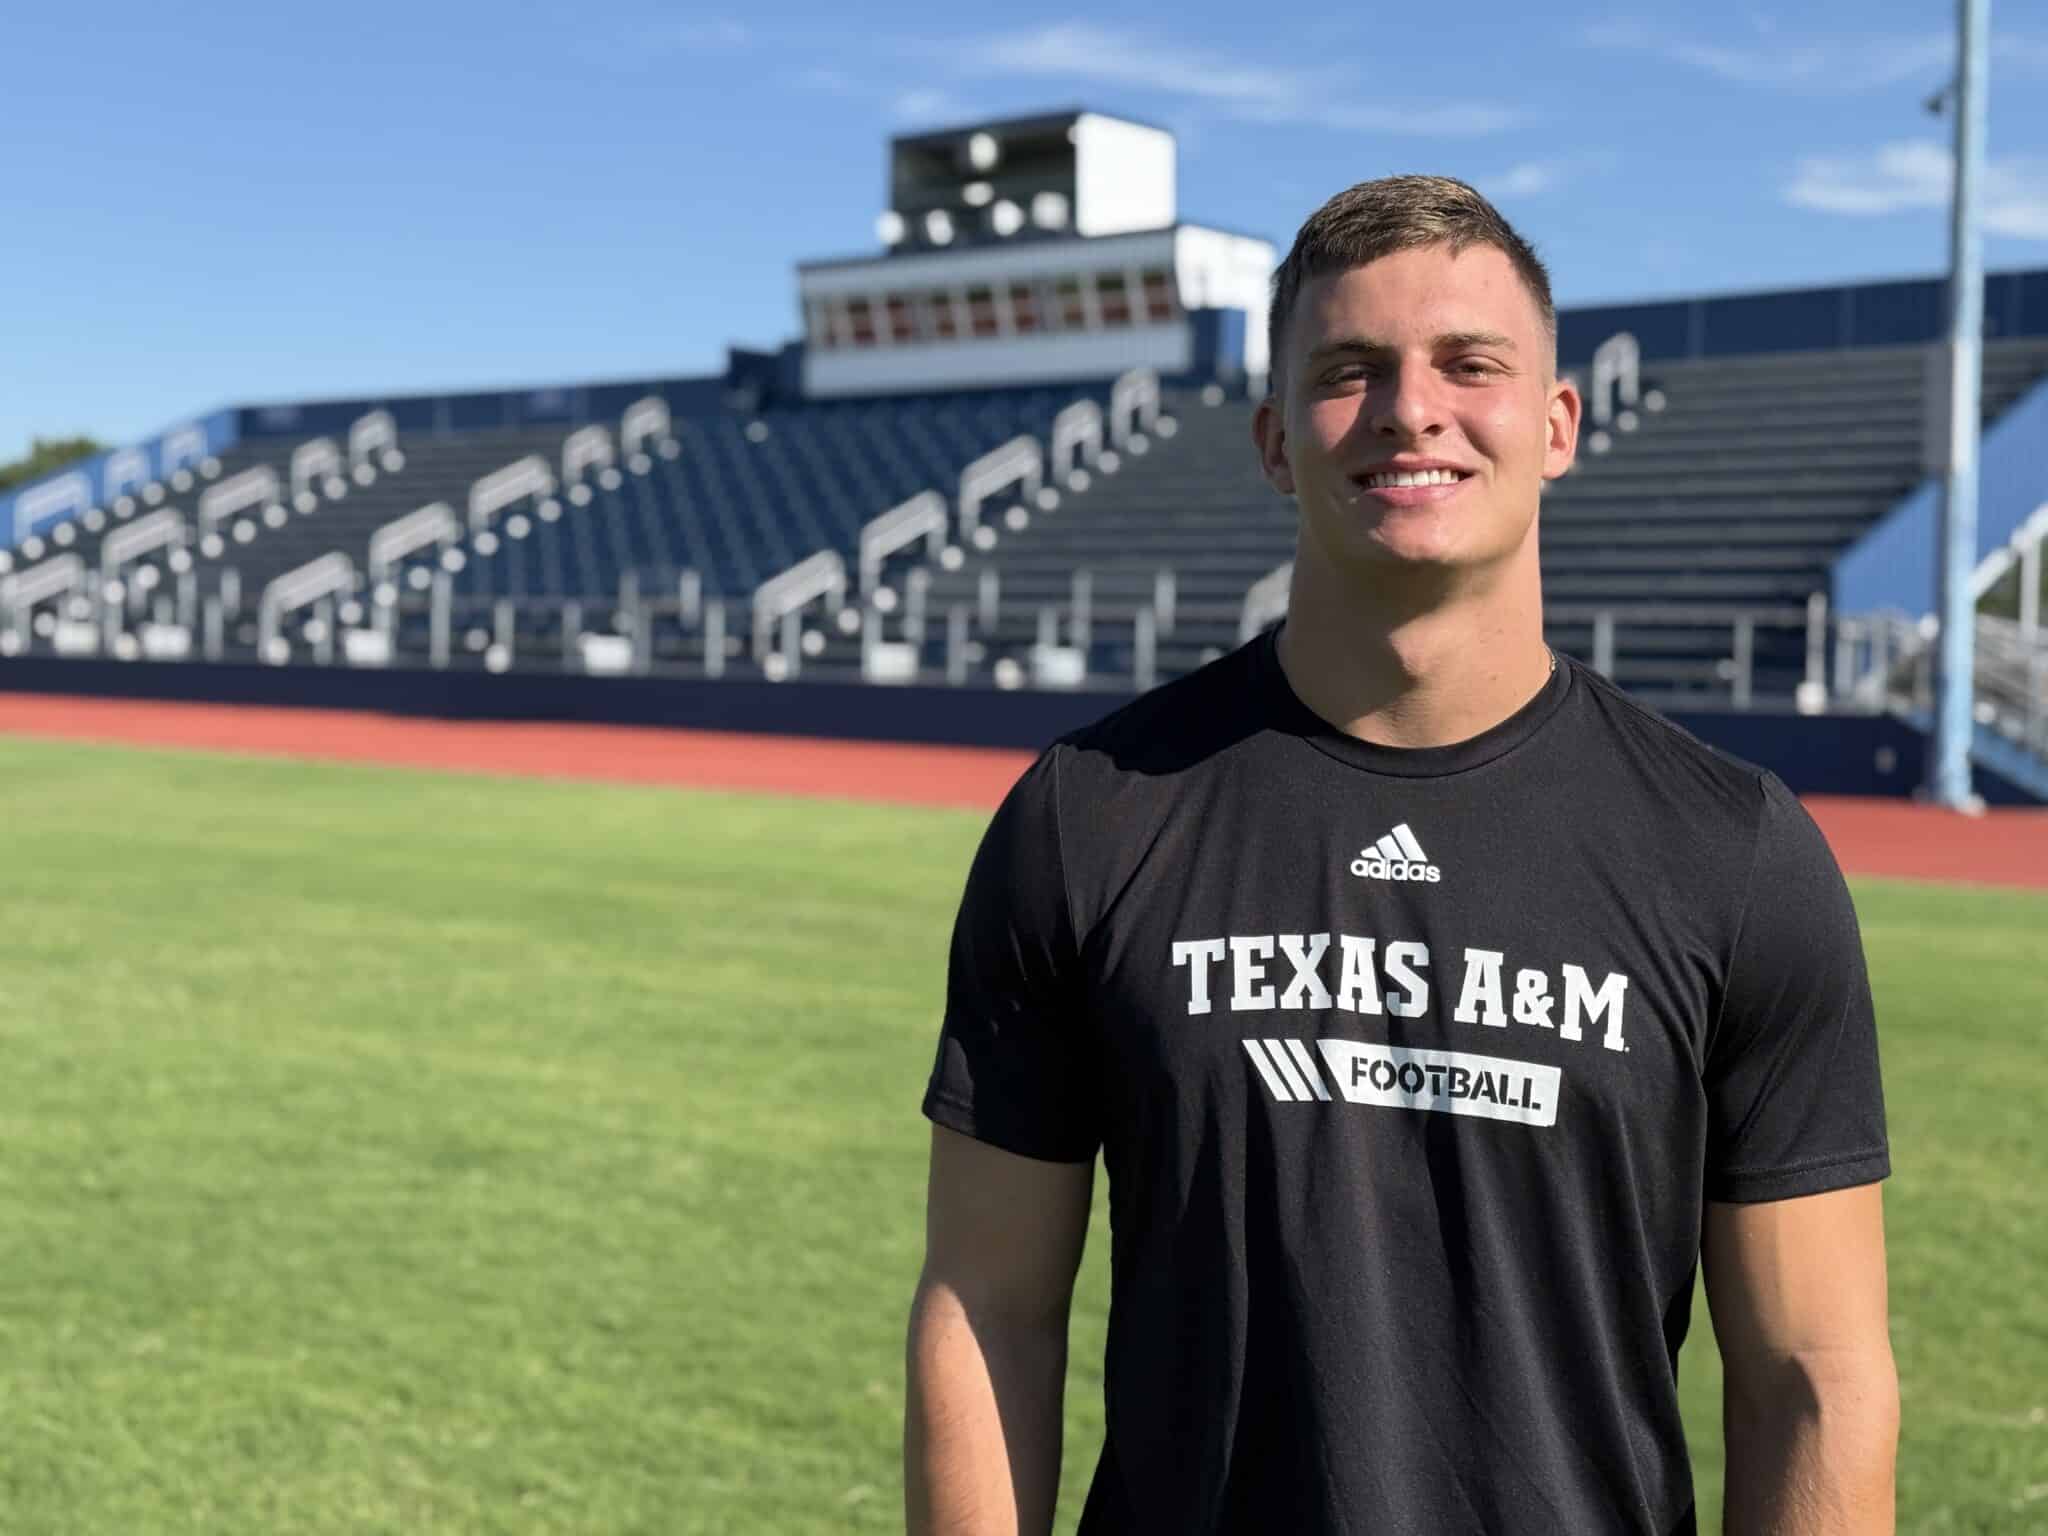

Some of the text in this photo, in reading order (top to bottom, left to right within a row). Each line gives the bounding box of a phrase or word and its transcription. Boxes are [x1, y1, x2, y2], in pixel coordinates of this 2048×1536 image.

[1350, 857, 1441, 883] adidas
[1172, 932, 1430, 1018] TEXAS
[1351, 1055, 1542, 1111] FOOTBALL
